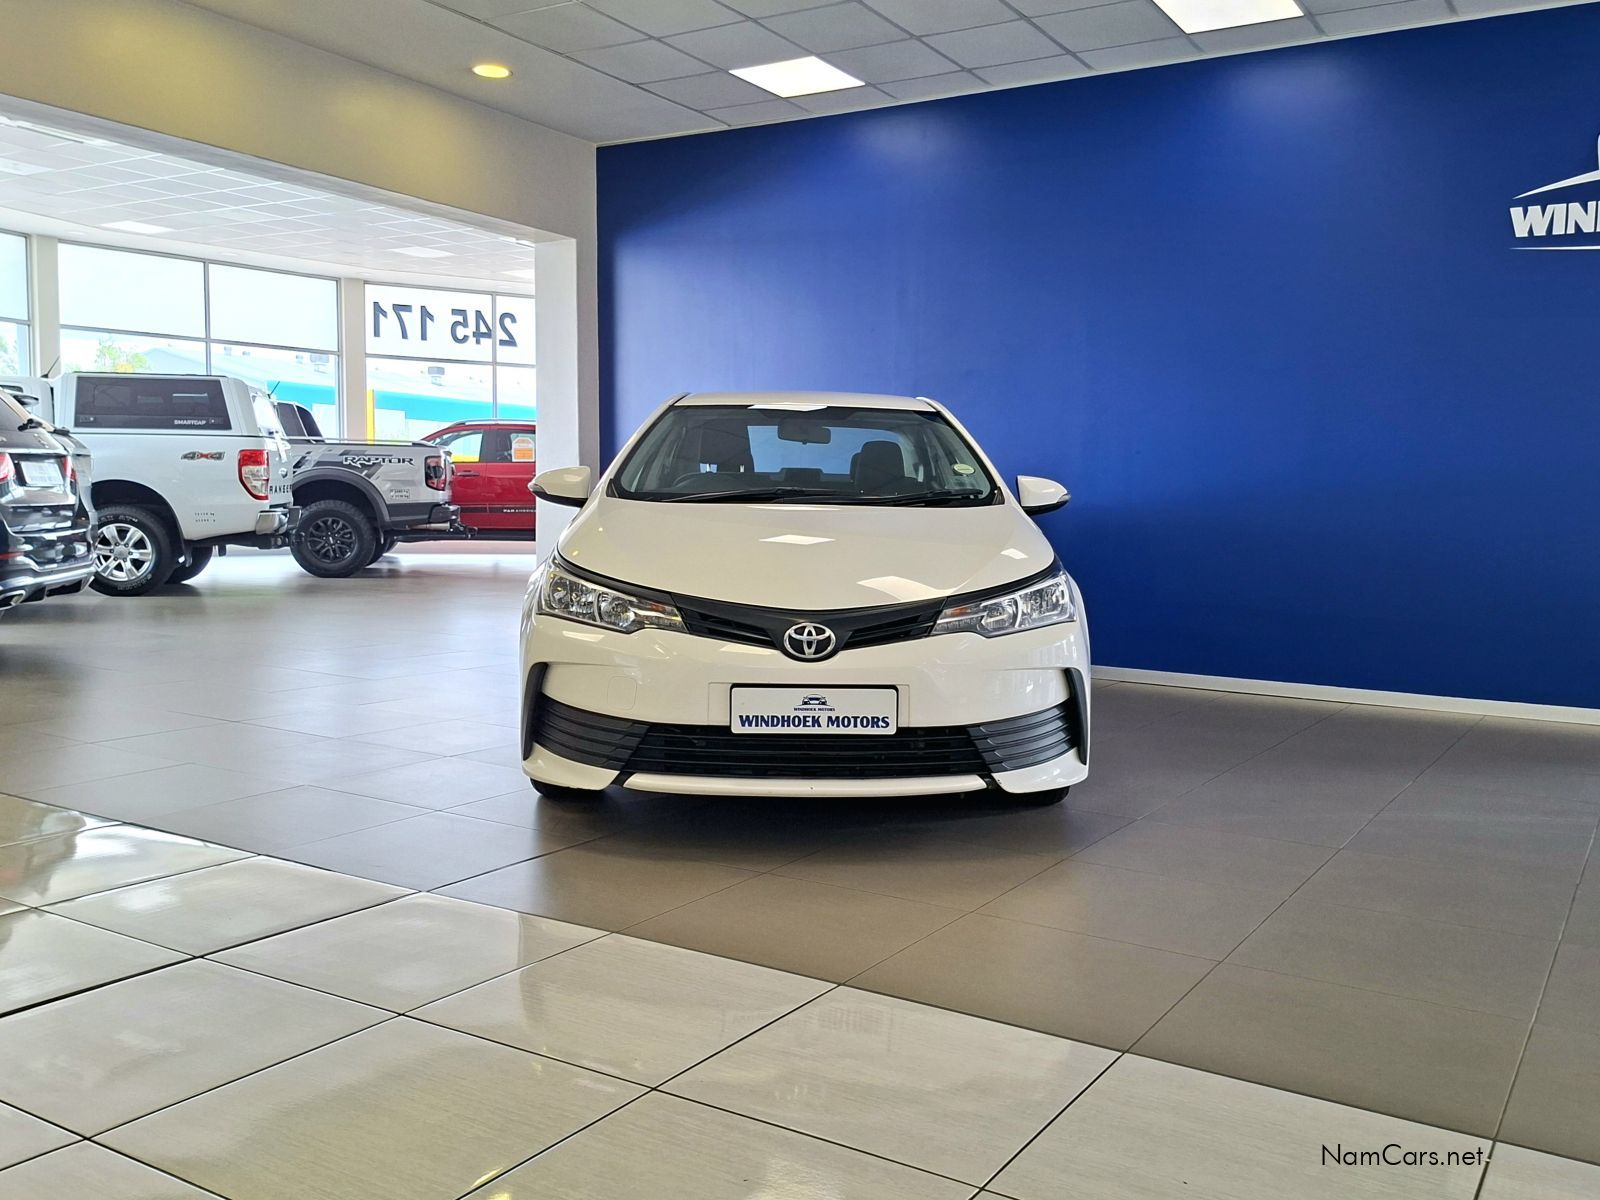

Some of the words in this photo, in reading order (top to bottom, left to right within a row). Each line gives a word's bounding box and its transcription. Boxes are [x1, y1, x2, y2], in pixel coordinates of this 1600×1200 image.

[1510, 201, 1600, 238] WIN
[342, 455, 415, 468] RAPTOR
[738, 714, 822, 728] WINDHOEK
[827, 715, 890, 729] MOTORS
